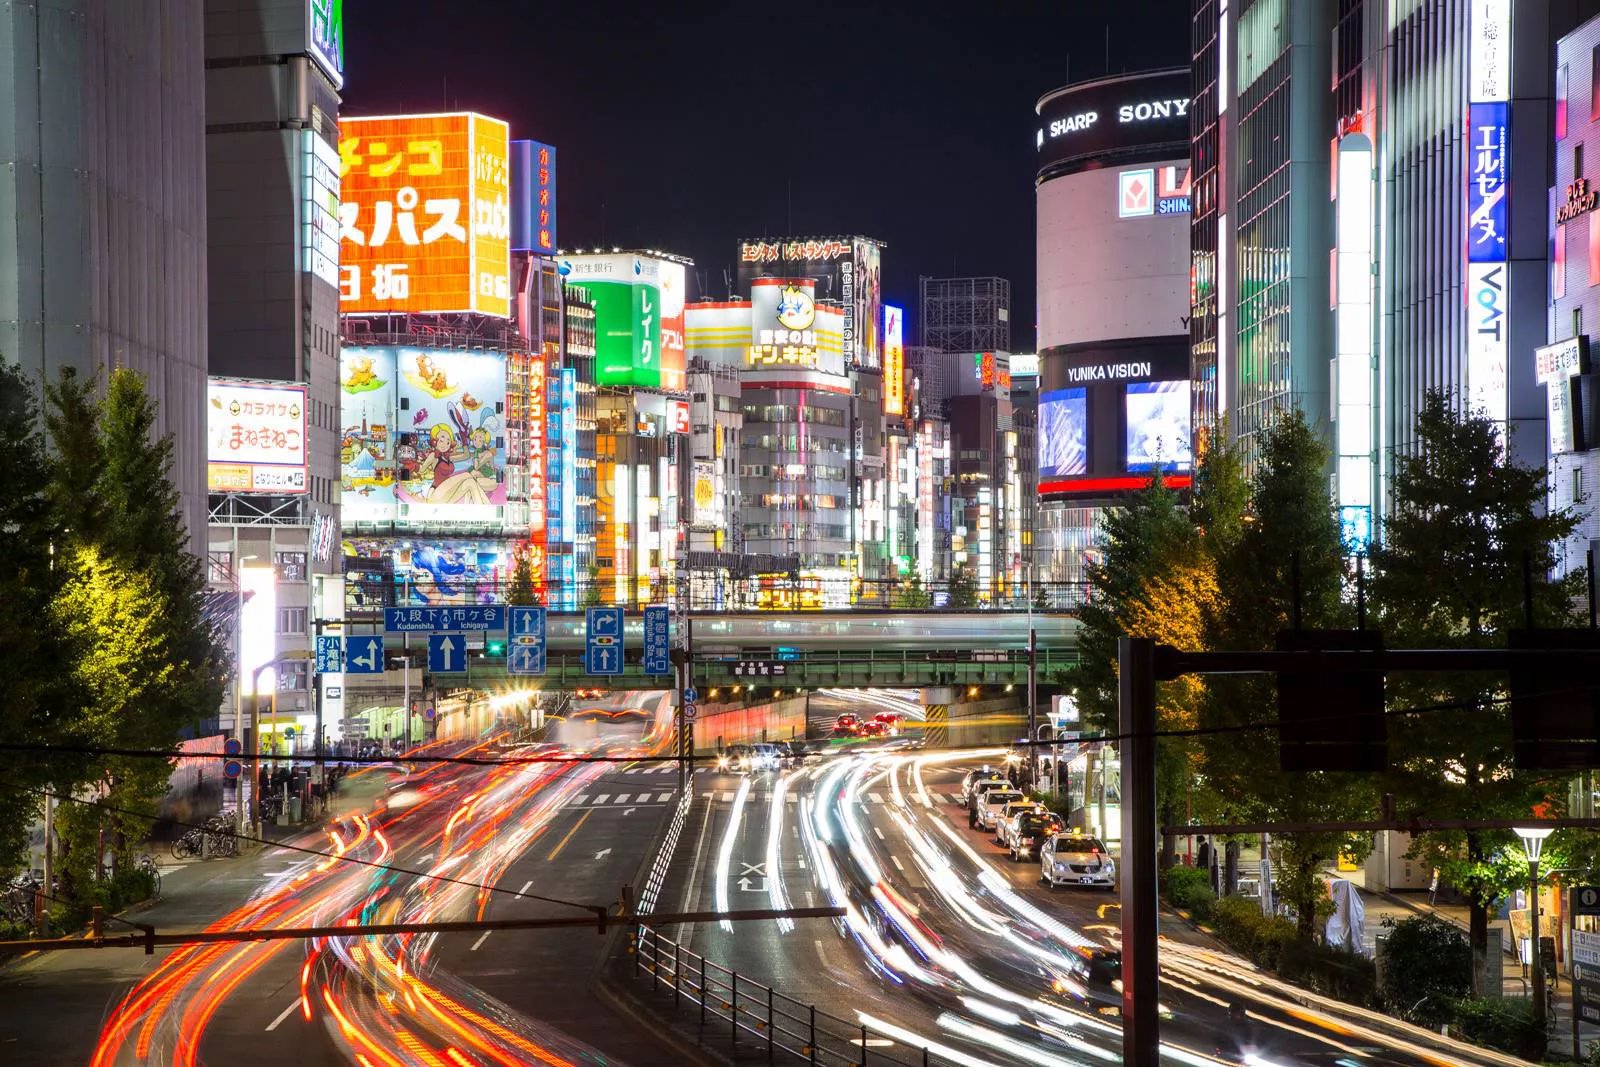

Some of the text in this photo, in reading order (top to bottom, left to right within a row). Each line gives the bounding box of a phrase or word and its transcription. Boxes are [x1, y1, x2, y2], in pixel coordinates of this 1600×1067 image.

[1050, 98, 1190, 138] SHARP SONY
[575, 263, 614, 274] 新生銀行
[641, 289, 652, 363] レイク
[1068, 362, 1151, 382] YUNIKA VISION
[243, 401, 288, 416] カラオケ
[229, 423, 300, 450] まねきねこ
[394, 609, 438, 622] 九段下
[460, 622, 489, 630] Ichigaya
[646, 611, 655, 642] Shinjuku
[326, 637, 340, 671] 小滝橋
[655, 610, 666, 671] 新宿駅東口
